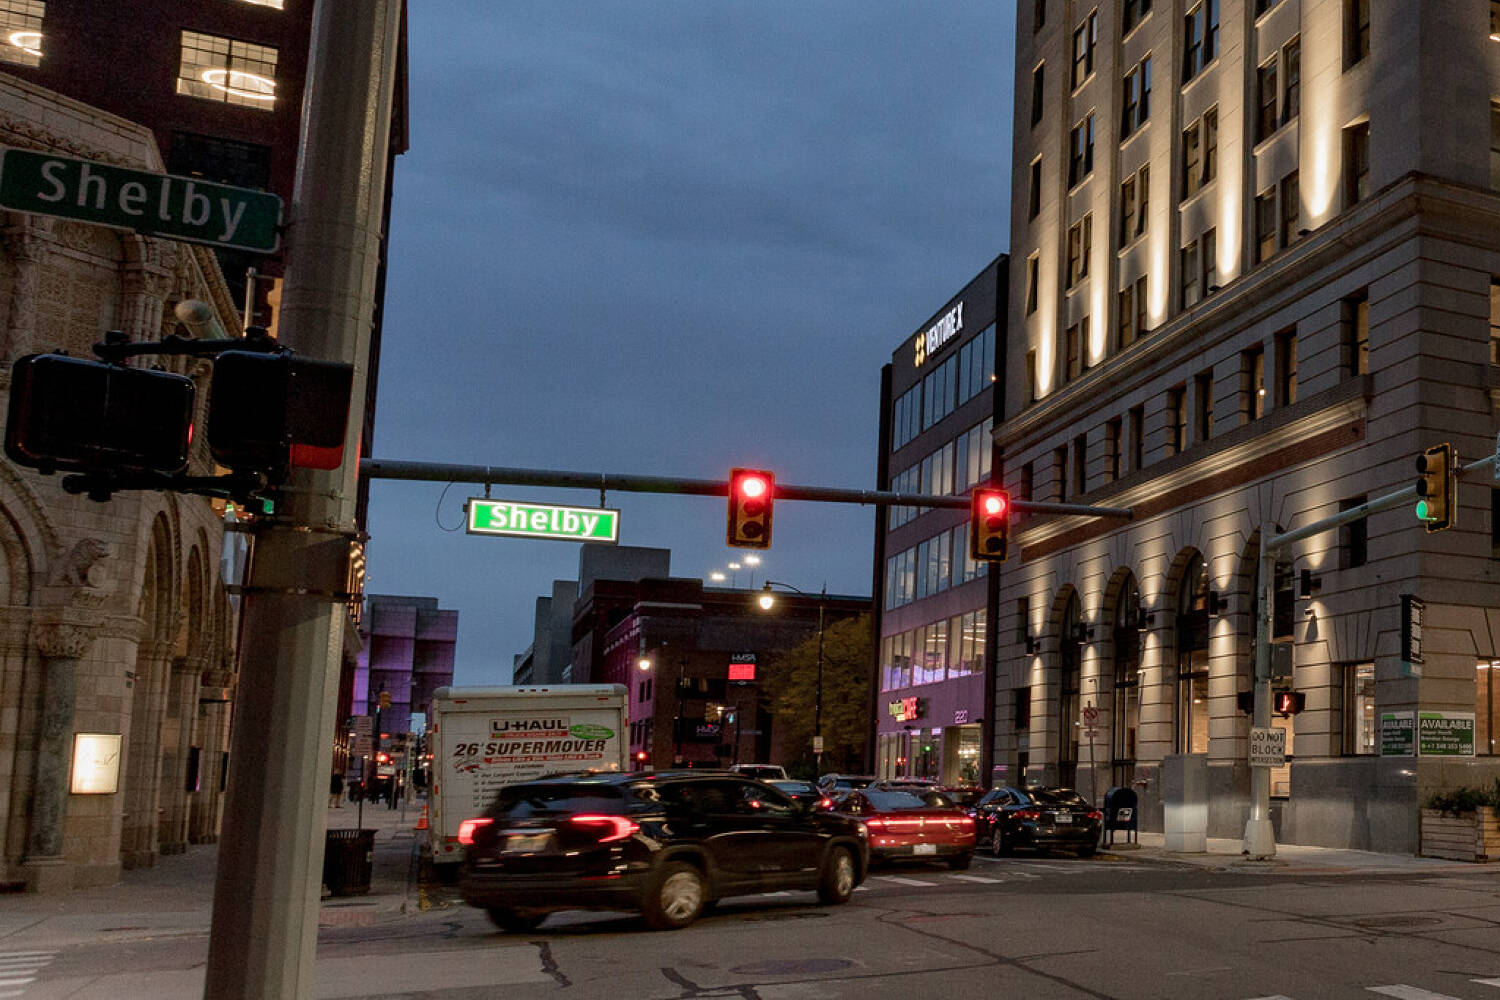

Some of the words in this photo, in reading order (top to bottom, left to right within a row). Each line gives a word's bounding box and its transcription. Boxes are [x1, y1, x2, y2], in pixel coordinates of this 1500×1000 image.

[37, 158, 248, 242] Shelby
[489, 503, 600, 538] Shelby
[493, 719, 568, 732] U-HAUL
[1421, 719, 1472, 729] AVAILABLE
[1252, 732, 1265, 742] DO
[1267, 732, 1284, 742] NOT
[485, 739, 606, 756] SUPERMOVER
[1252, 744, 1283, 755] BLOCK
